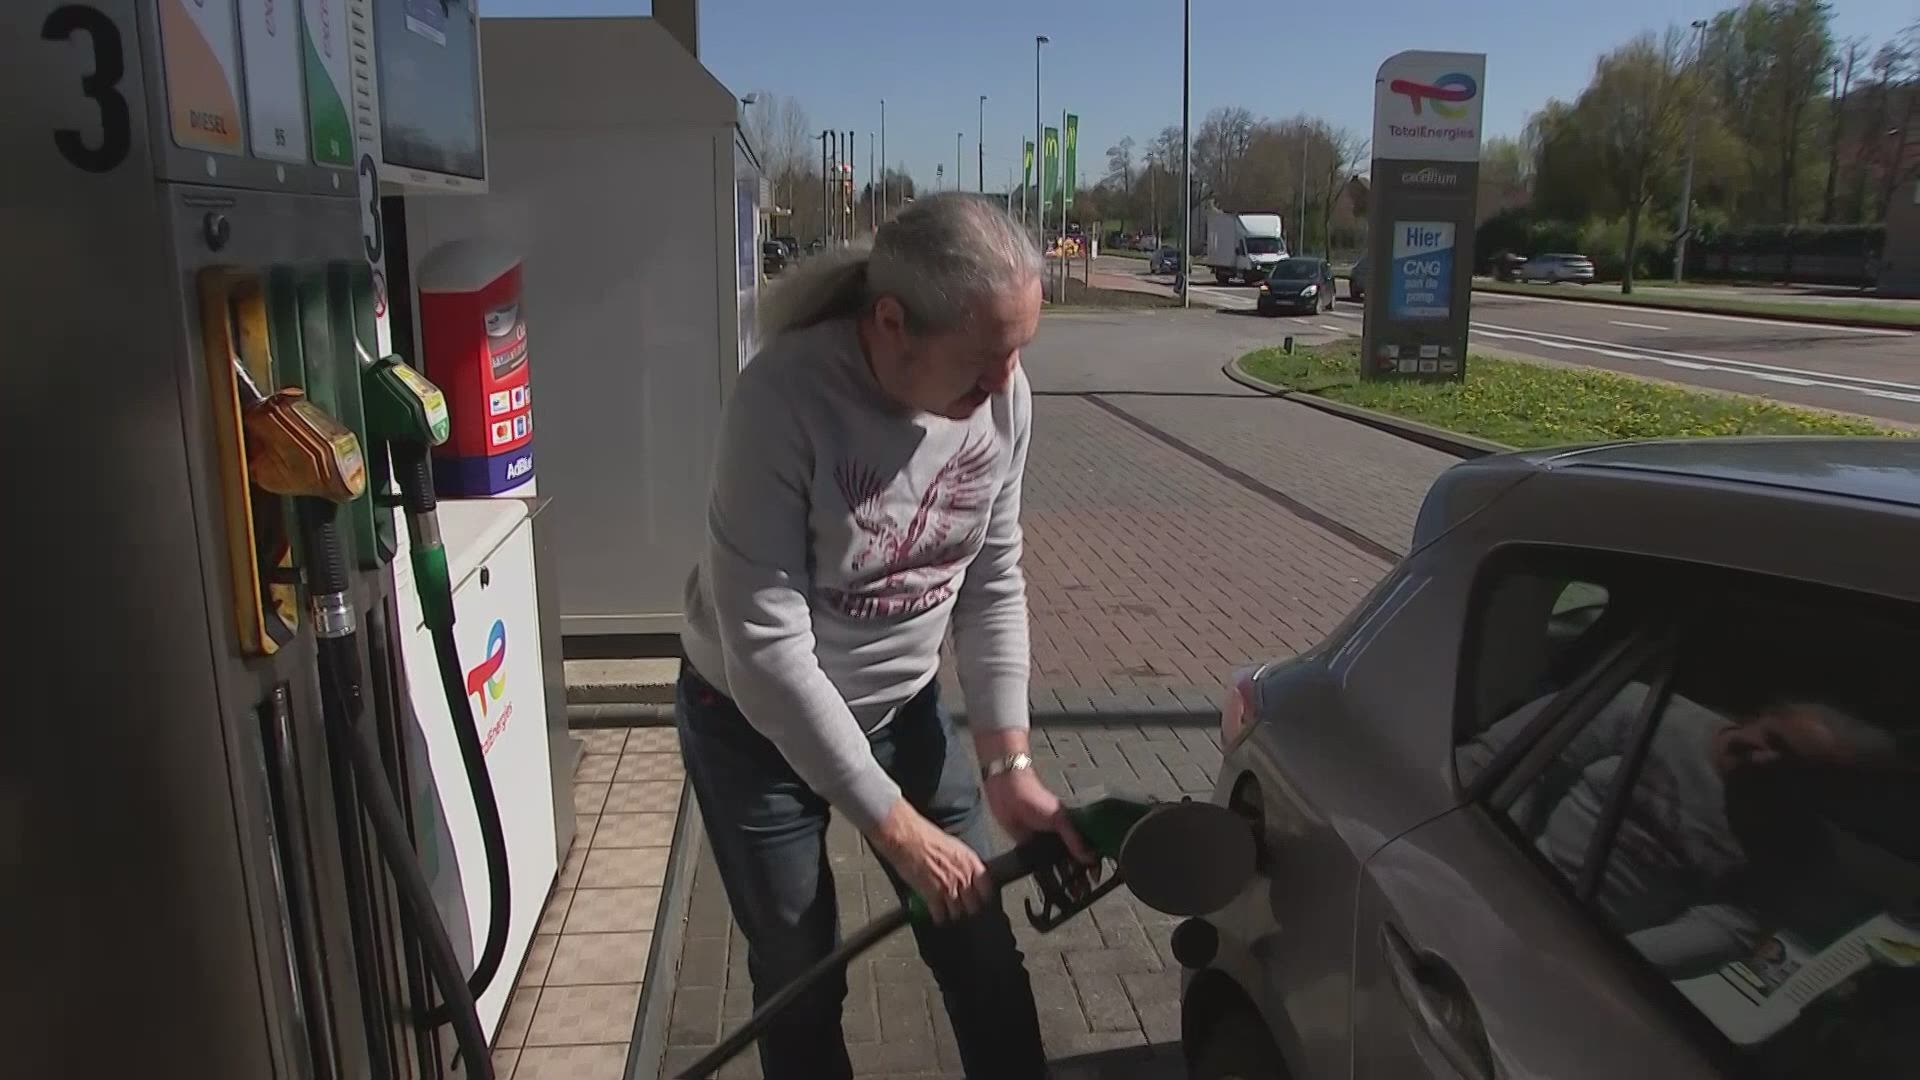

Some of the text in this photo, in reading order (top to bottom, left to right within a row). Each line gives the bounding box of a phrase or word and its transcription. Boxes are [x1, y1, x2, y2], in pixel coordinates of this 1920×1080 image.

[41, 5, 131, 173] 3
[190, 109, 228, 135] DIESEL
[1389, 125, 1475, 140] TotalEnergies
[360, 153, 381, 262] 3
[1406, 227, 1442, 247] Hier
[1403, 260, 1441, 275] CNG
